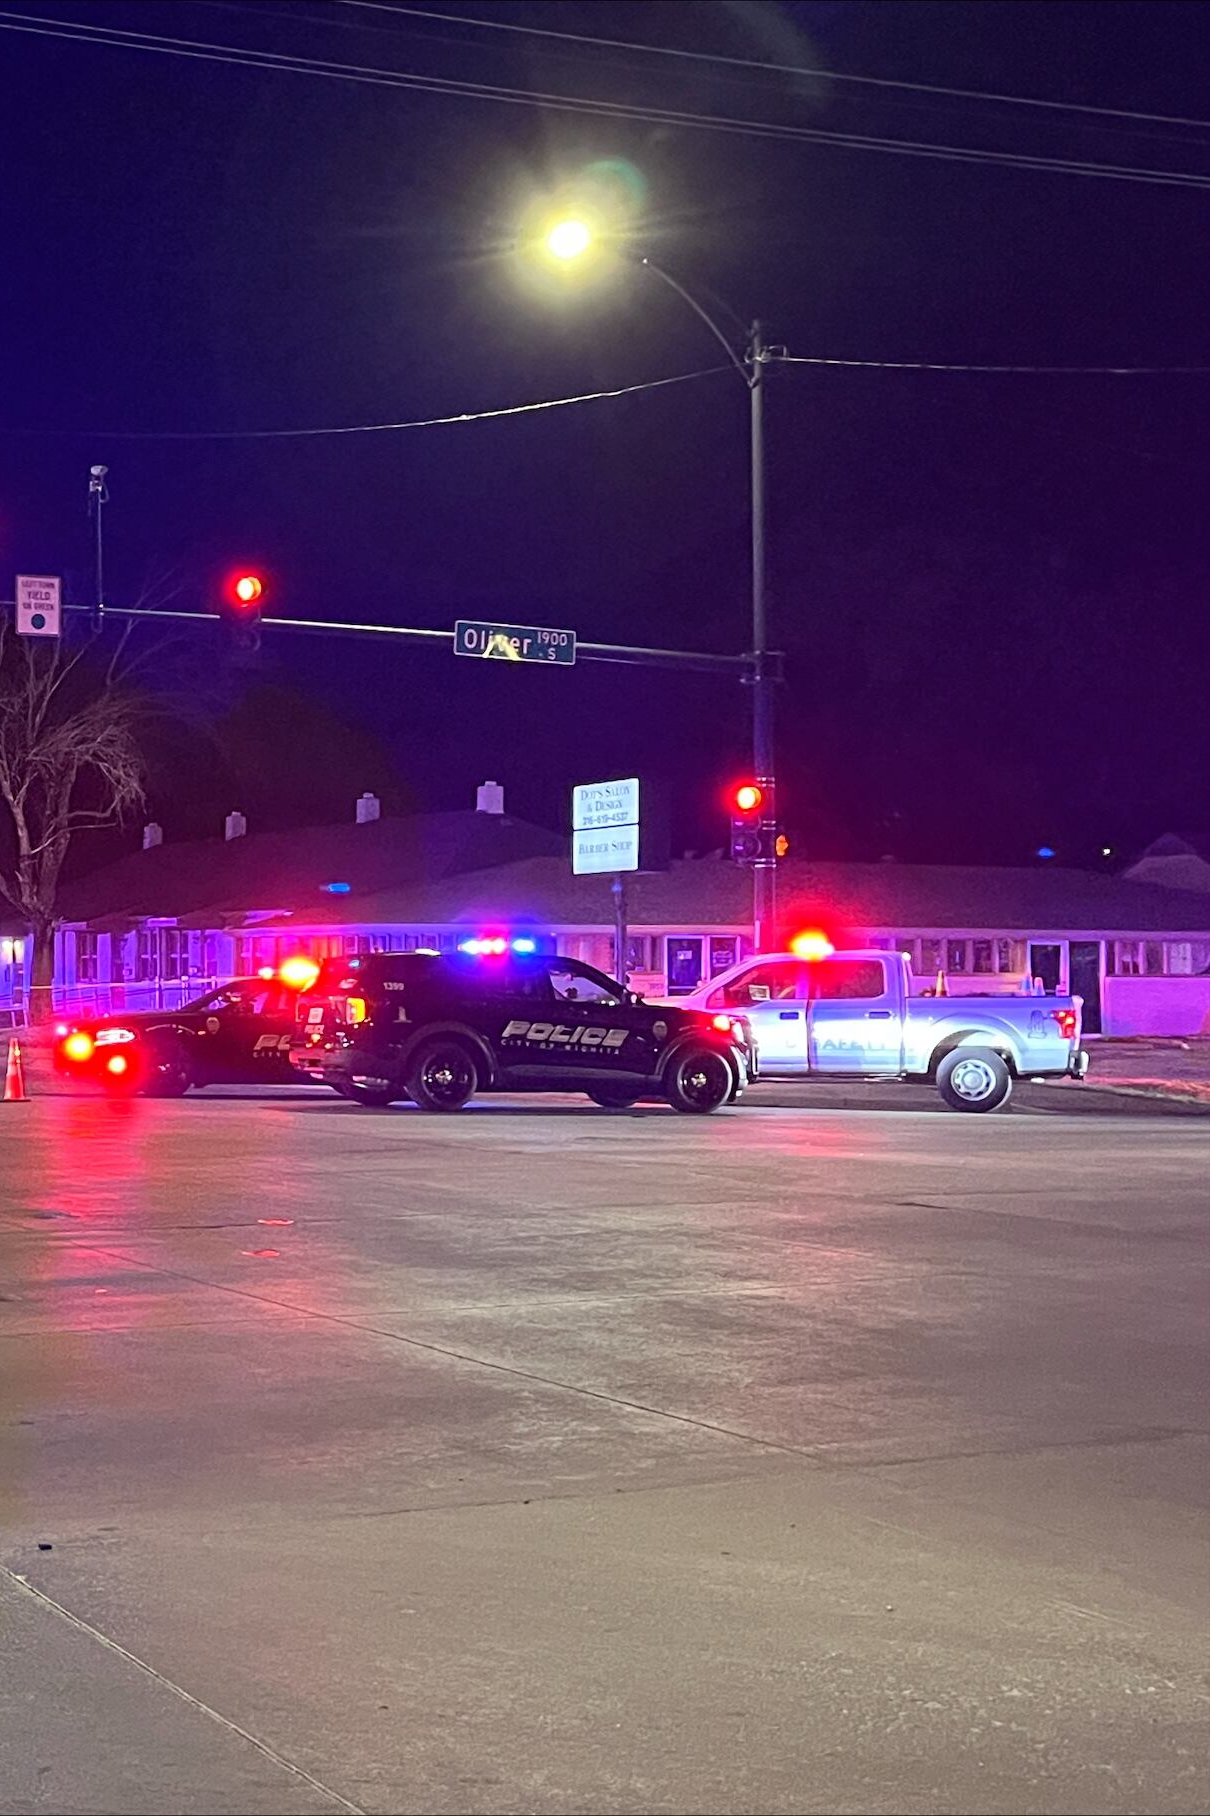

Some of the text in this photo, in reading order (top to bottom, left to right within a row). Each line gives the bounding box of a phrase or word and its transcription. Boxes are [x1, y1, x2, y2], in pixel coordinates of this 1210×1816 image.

[27, 591, 51, 601] YIELD
[537, 631, 568, 646] 1900
[548, 647, 557, 660] S
[501, 1020, 630, 1047] POLICE
